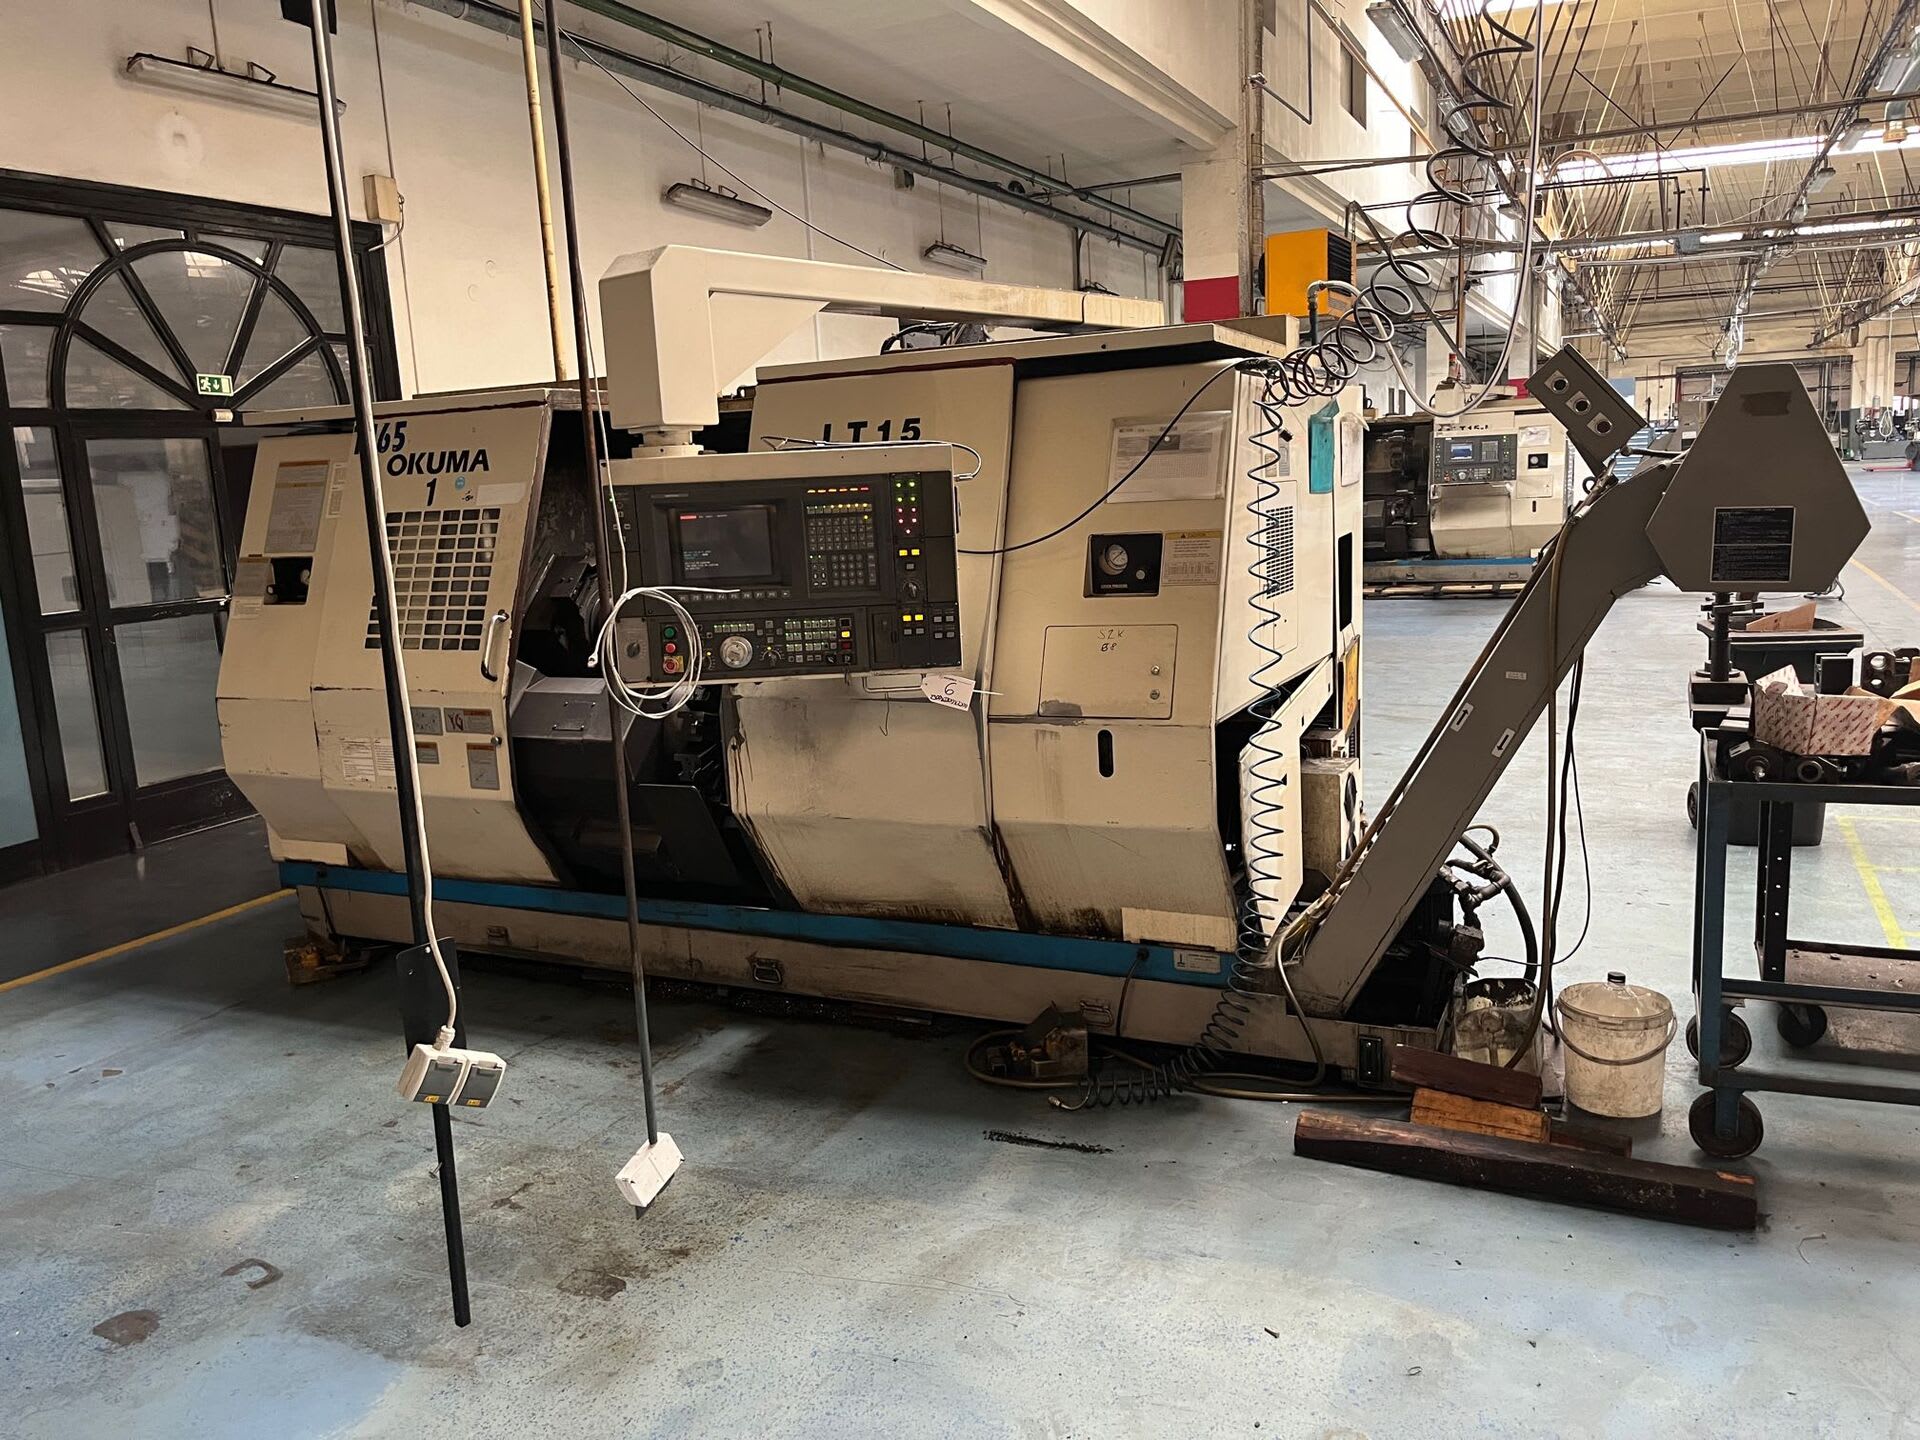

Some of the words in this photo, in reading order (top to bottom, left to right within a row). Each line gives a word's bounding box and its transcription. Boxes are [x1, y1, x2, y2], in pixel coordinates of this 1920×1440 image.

[387, 448, 490, 477] OKUMA
[426, 477, 437, 507] 1
[944, 682, 957, 696] 6
